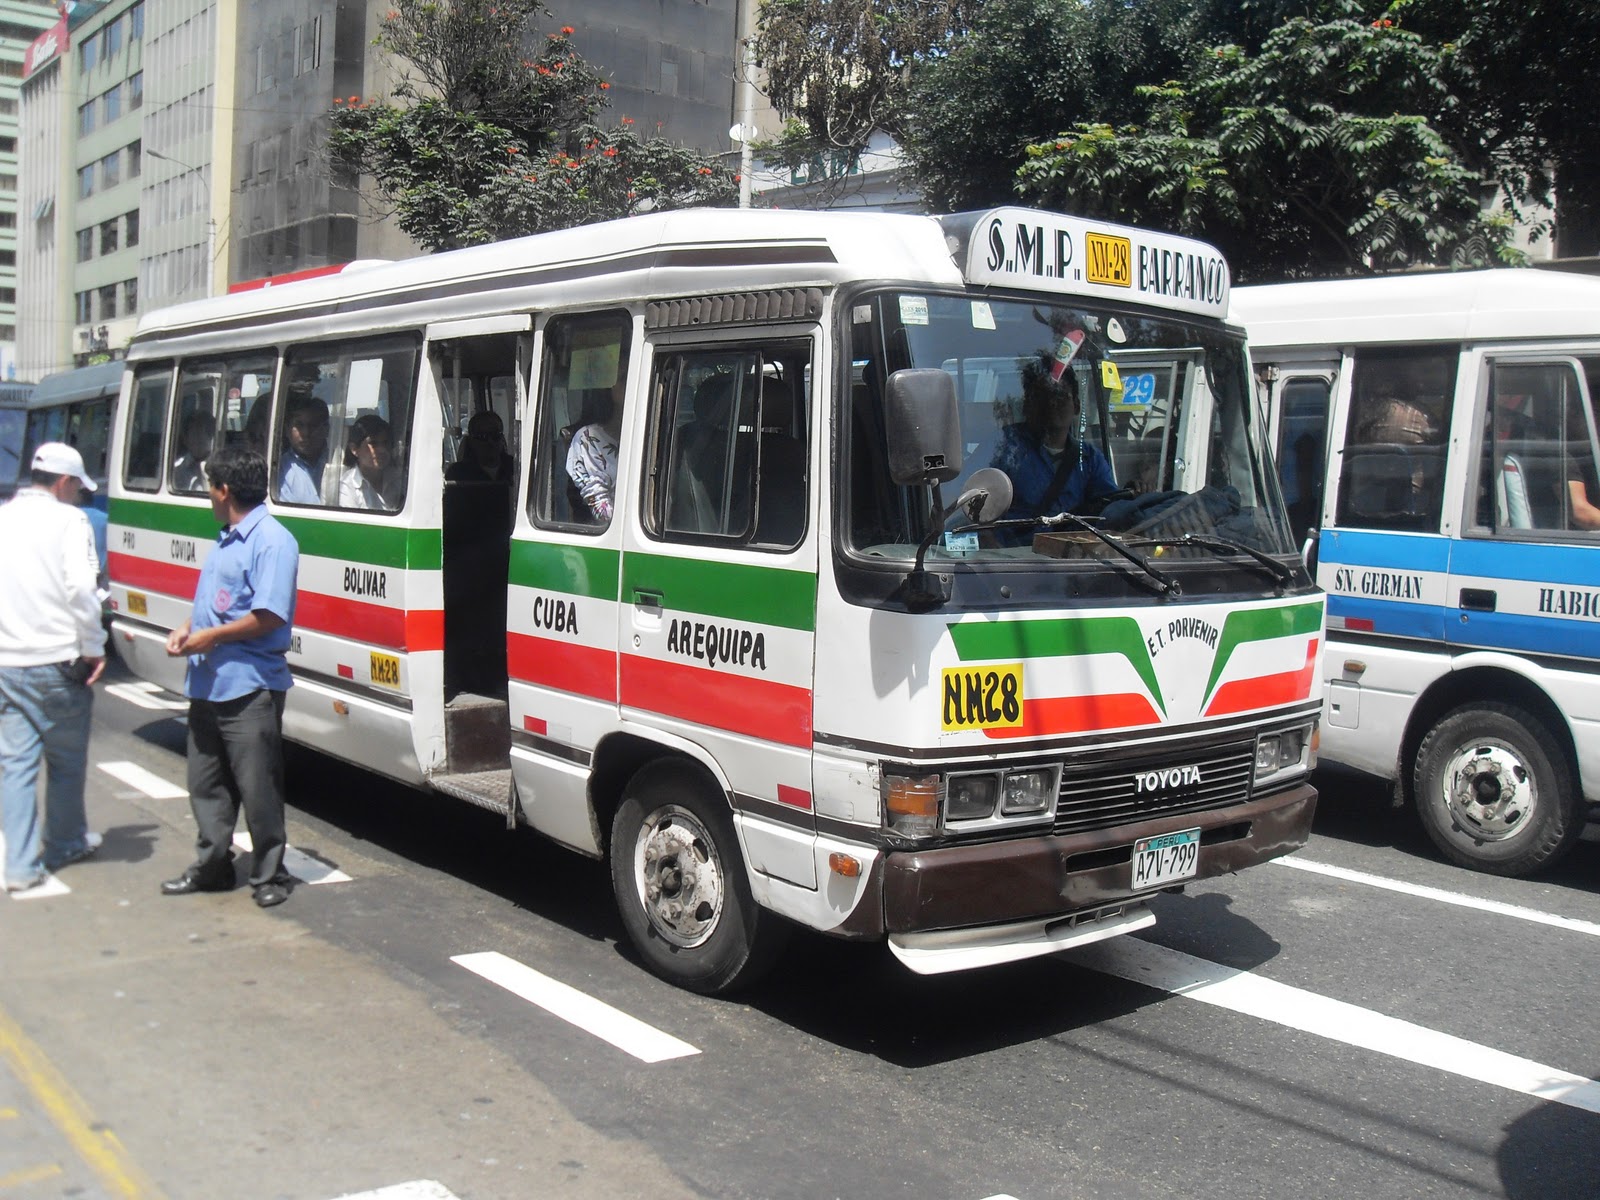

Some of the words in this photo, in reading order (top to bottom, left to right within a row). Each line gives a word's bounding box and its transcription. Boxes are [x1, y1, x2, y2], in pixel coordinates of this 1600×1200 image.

[1137, 244, 1225, 304] BARRANCO
[1122, 373, 1154, 404] 29
[122, 531, 135, 550] PRO
[171, 538, 196, 563] COVIDA
[343, 566, 386, 599] BOLIVAR
[1361, 571, 1423, 600] GERMAN
[533, 595, 579, 636] CUBA
[667, 618, 767, 671] AREQUIPA
[1168, 617, 1219, 650] PORVENIR
[1135, 765, 1201, 793] TOYOTA
[1156, 836, 1180, 850] PERU
[1136, 842, 1197, 882] A7V-799
